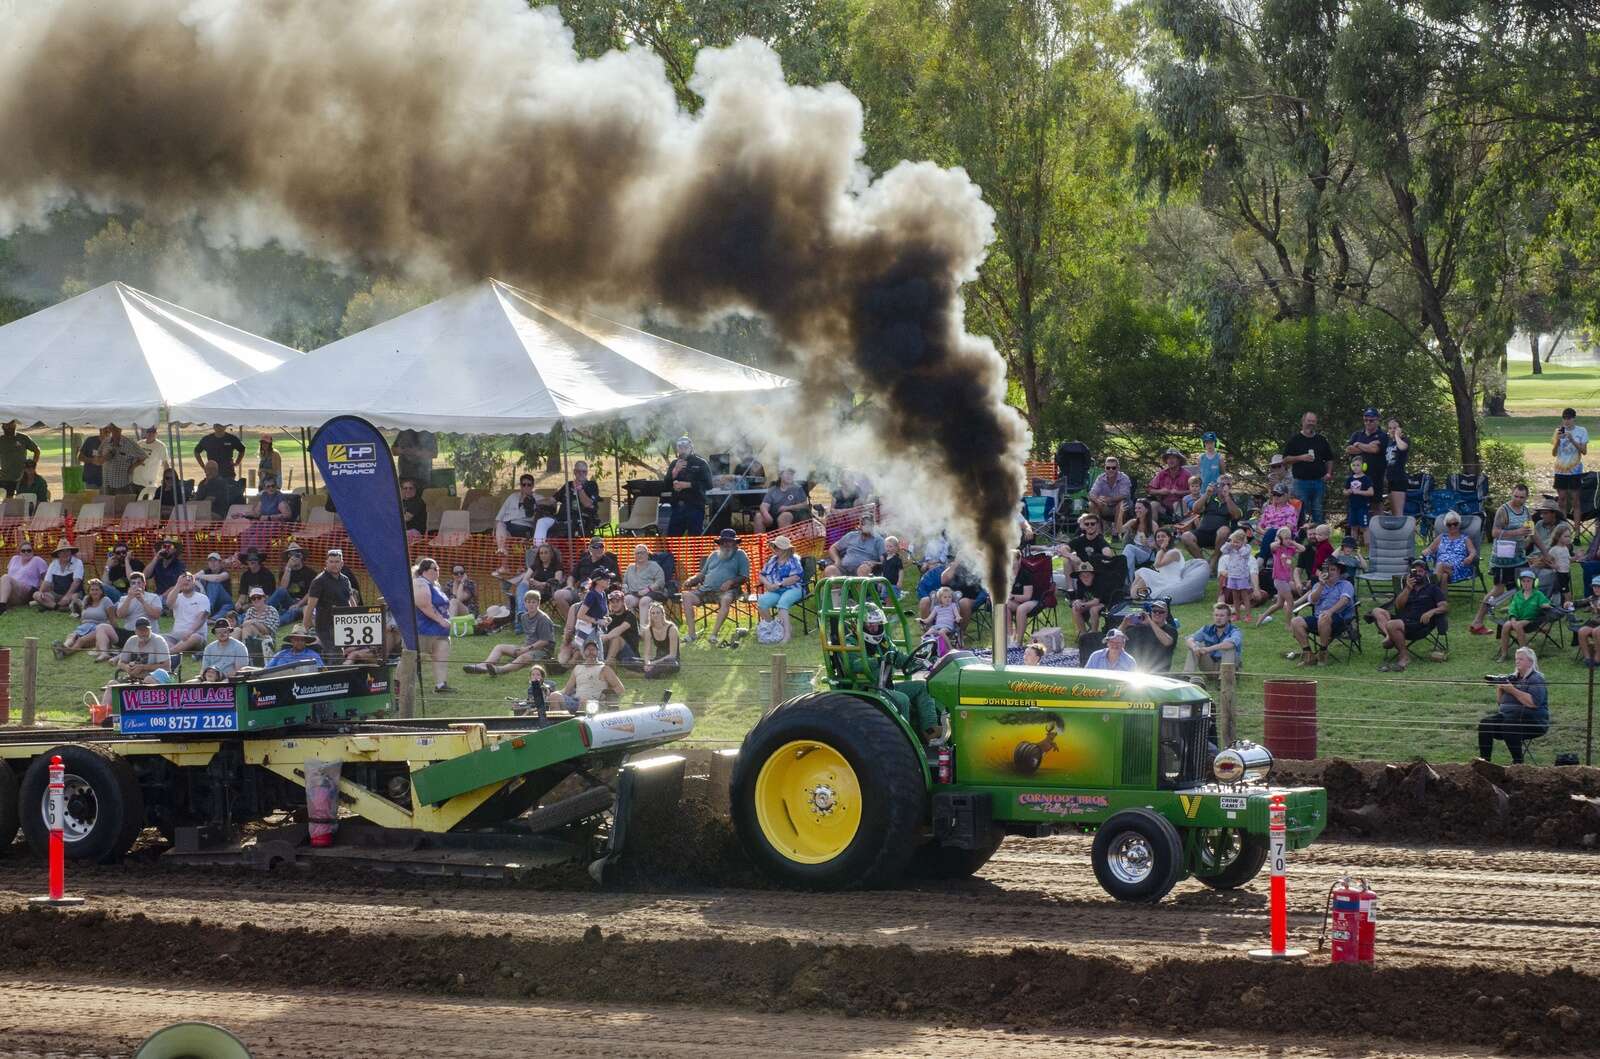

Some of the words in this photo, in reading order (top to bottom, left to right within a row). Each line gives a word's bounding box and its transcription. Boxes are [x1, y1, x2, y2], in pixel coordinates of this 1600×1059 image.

[348, 447, 372, 458] HP
[335, 615, 380, 624] PROSTOCK
[344, 626, 374, 645] 3.8
[122, 689, 168, 711] WEBB
[168, 687, 235, 709] HAULAGE
[150, 717, 167, 727] (08)
[168, 716, 198, 729] 8757
[202, 715, 233, 728] 2126
